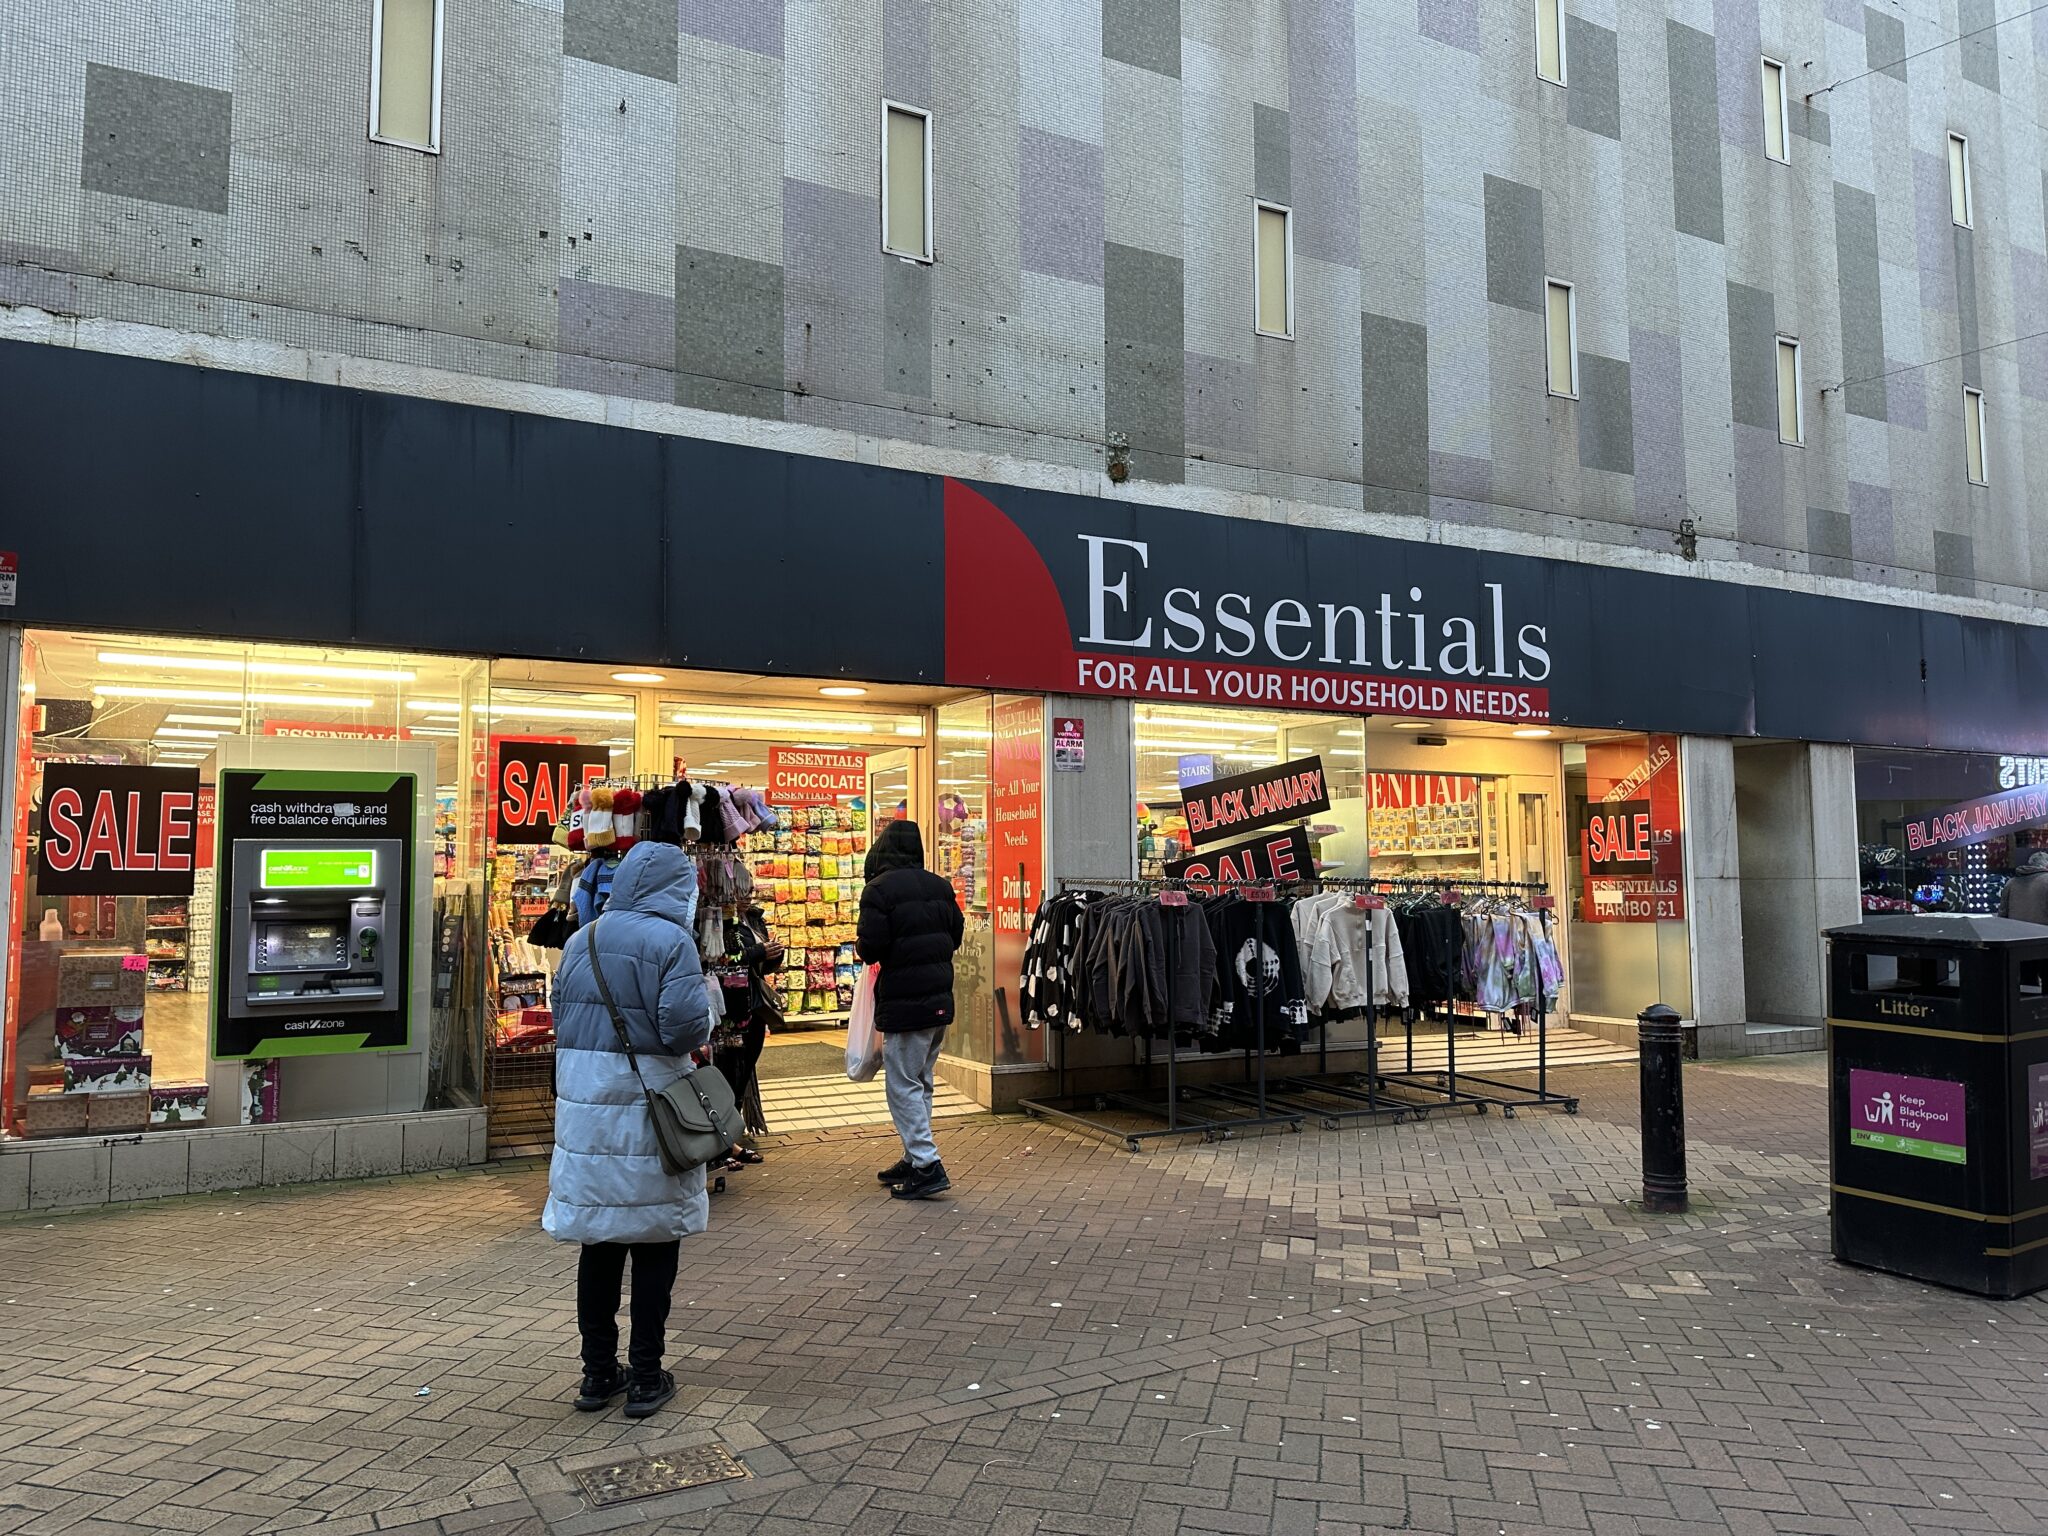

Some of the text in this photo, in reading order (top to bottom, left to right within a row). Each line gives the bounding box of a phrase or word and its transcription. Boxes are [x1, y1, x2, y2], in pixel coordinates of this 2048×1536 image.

[1077, 533, 1552, 683] Essentials
[1077, 658, 1551, 720] FOR ALL YOUR HOUSEHOLD NEEDS...
[1055, 740, 1083, 748] ALARM
[776, 752, 864, 768] ESSENTIALS
[775, 771, 865, 791] CHOCOLATE
[1181, 765, 1211, 778] STAIRS
[1601, 744, 1673, 804] SSENTIALS
[501, 759, 609, 827] SAL
[1008, 779, 1019, 797] All
[1021, 778, 1040, 796] Your
[1367, 772, 1478, 809] ENTIAL
[250, 802, 388, 814] cash withdrals and
[1186, 769, 1323, 834] BLACK JANUARY
[250, 814, 388, 828] free balance enquiries
[995, 803, 1038, 823] Household
[1906, 790, 2048, 852] BLACK JANUARY
[45, 786, 195, 872] SALE
[1004, 830, 1029, 847] Needs
[1589, 813, 1651, 864] SALE
[1183, 836, 1300, 897] SALE
[1591, 879, 1678, 894] ESSENTIALS
[1594, 900, 1676, 917] HARIBO £1
[1880, 998, 1929, 1018] Litter
[1898, 1094, 1926, 1107] Keep
[1898, 1106, 1949, 1122] Blackpool
[1898, 1117, 1922, 1132] Tidy
